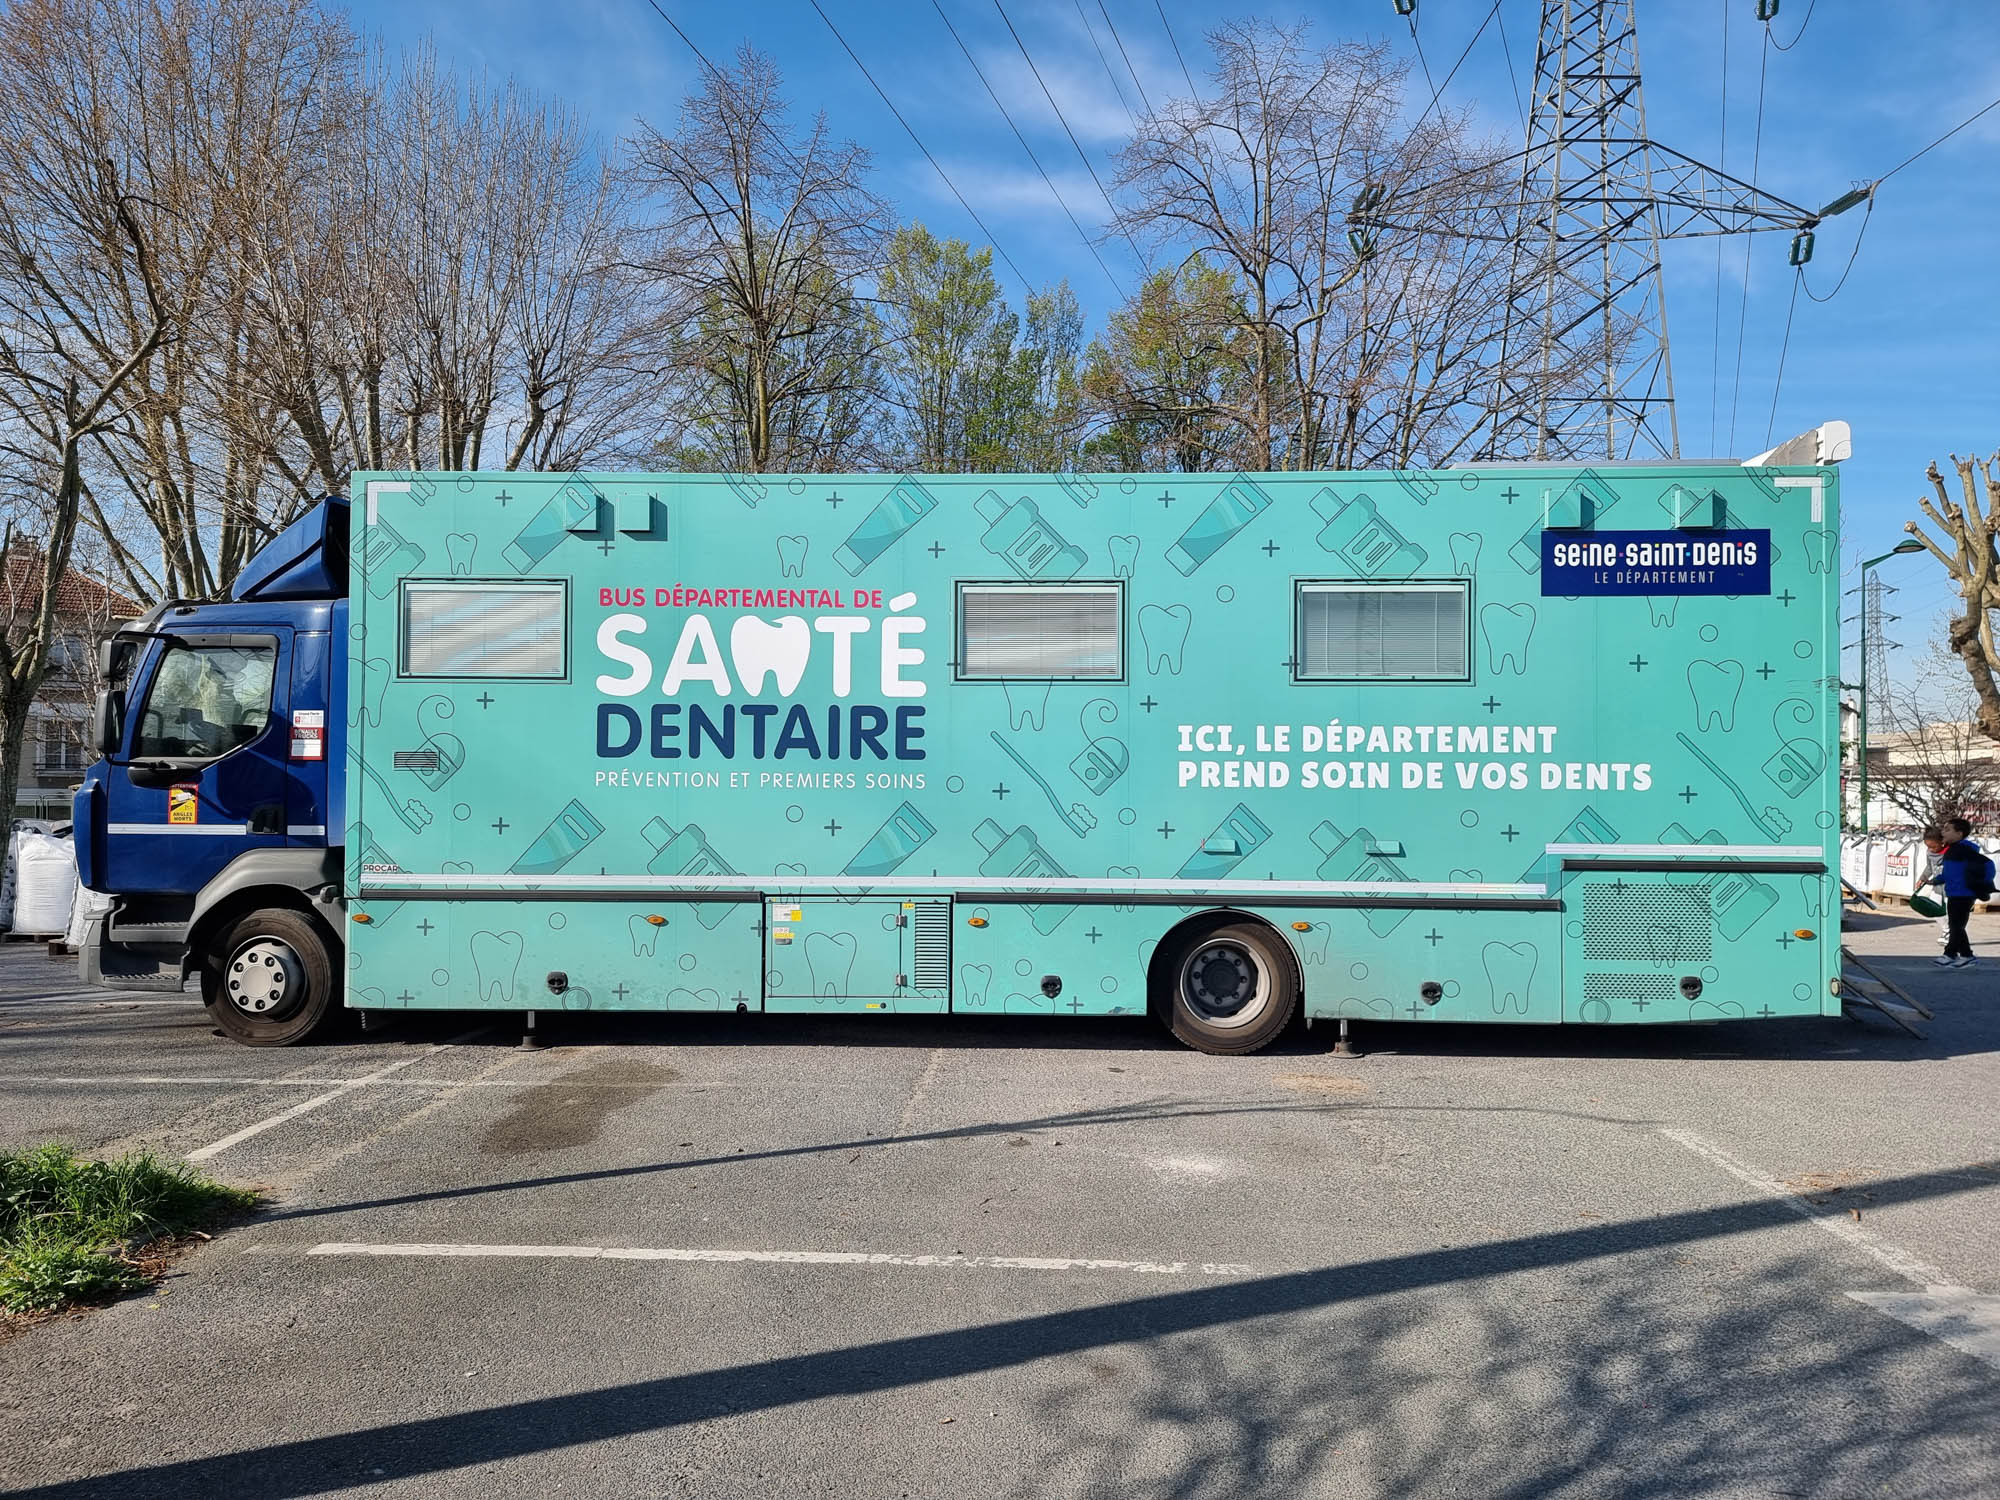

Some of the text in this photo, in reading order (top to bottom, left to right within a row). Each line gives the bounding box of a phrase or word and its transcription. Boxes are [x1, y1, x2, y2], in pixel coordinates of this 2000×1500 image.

[1594, 569, 1715, 584] LE DÉPARTEMENT
[598, 583, 883, 609] BUS DÉPARTEMENTAL DE
[596, 703, 927, 761] DENTAIRE
[1177, 718, 1557, 756] ICI, LE DÉPARTEMENT
[595, 768, 926, 789] PRÉVENTION ET PREMIERS SOINS
[1178, 761, 1652, 791] PREND SOIN DE VOS DENTS
[363, 864, 398, 872] PROCAR
